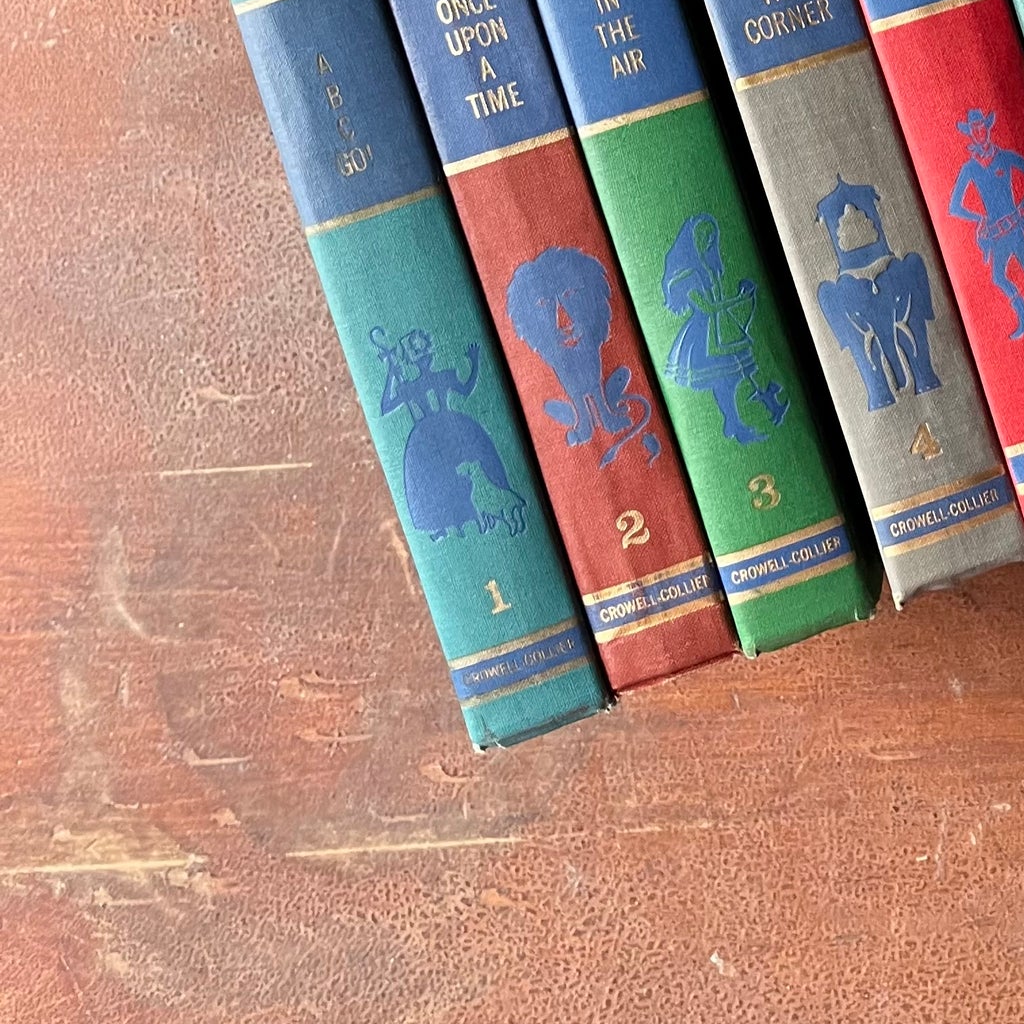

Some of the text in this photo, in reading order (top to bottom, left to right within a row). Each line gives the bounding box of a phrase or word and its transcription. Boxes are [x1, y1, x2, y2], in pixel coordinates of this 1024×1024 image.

[445, 16, 509, 57] UPON
[594, 14, 640, 49] THE
[316, 52, 333, 75] A
[479, 56, 498, 82] A
[610, 48, 647, 81] AIR
[326, 84, 343, 110] B
[465, 81, 524, 120] TIME
[910, 422, 943, 462] 4
[748, 473, 783, 511] 3
[615, 509, 651, 550] 2
[484, 578, 512, 616] 1
